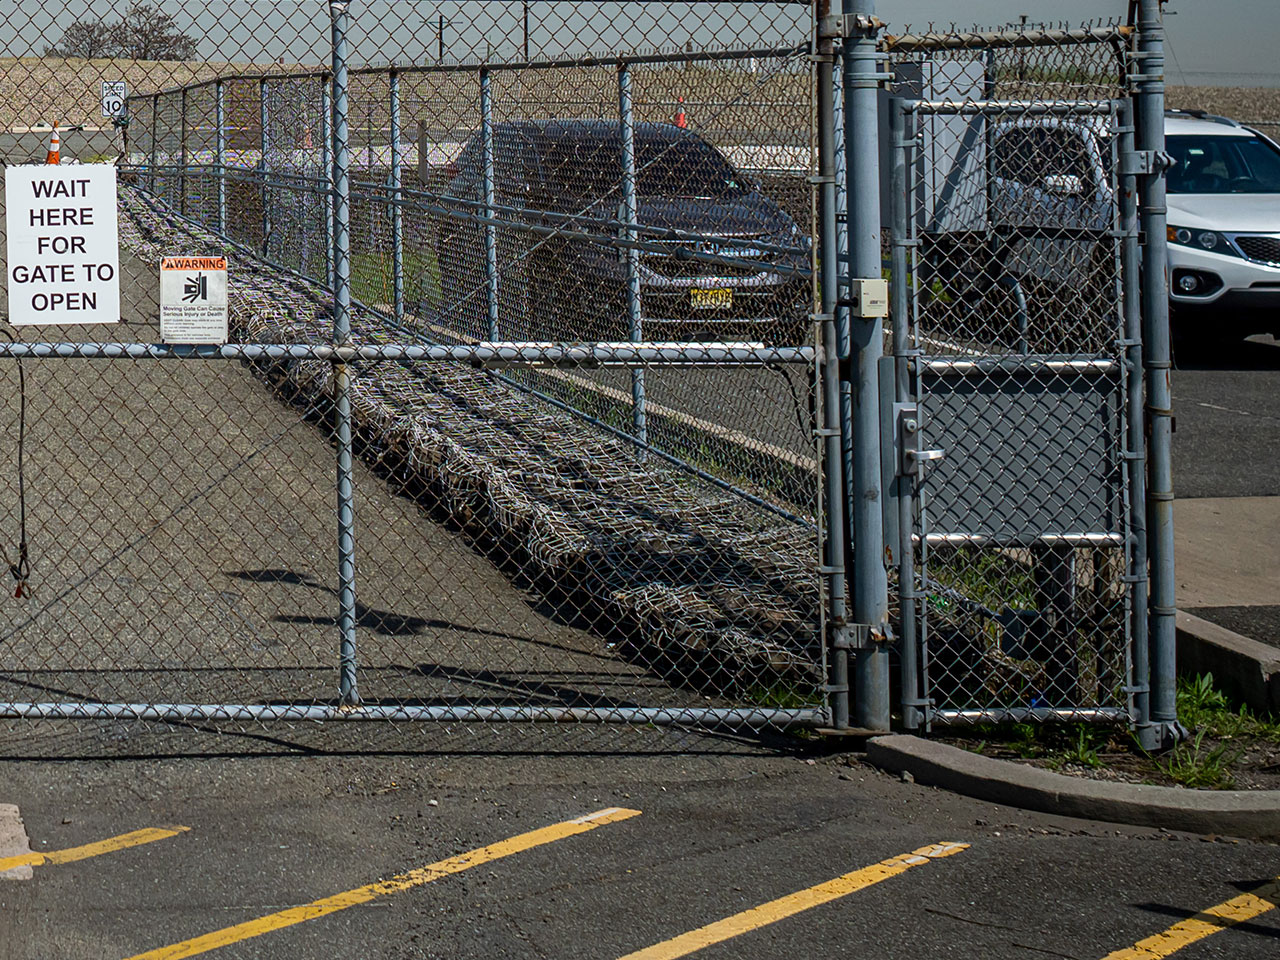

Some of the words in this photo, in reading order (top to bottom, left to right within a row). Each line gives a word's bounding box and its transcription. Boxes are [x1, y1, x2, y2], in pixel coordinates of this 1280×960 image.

[107, 101, 120, 111] 10
[32, 180, 90, 198] WAIT
[30, 208, 93, 226] HERE
[38, 237, 86, 254] FOR
[174, 260, 223, 268] WARNING
[13, 265, 75, 283] GATE
[83, 264, 113, 281] TO
[32, 293, 96, 311] OPEN
